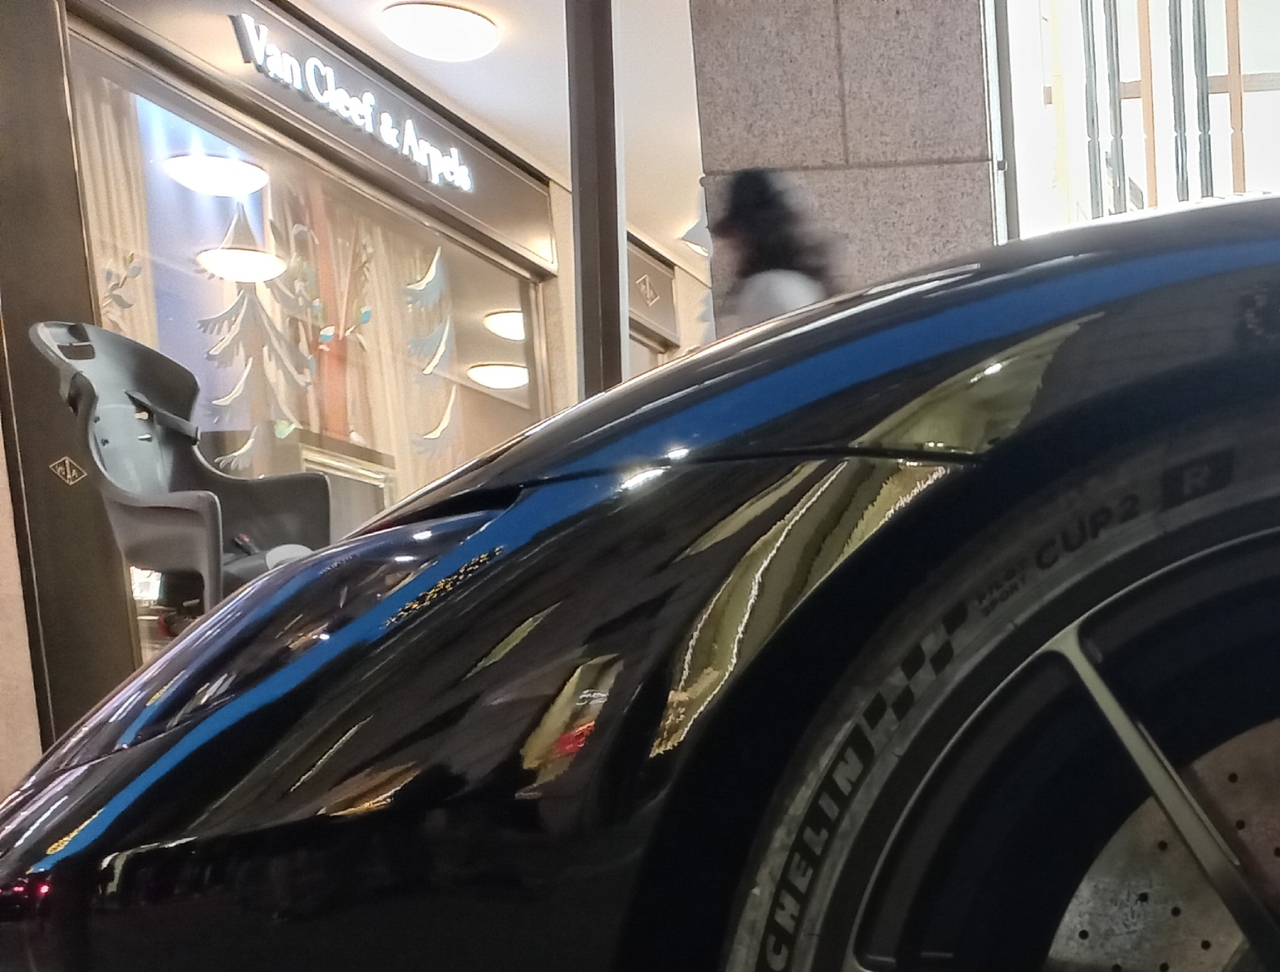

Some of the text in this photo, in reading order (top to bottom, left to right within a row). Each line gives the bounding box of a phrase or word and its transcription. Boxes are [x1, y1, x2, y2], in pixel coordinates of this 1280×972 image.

[241, 13, 474, 191] Van Cleef & Arpels
